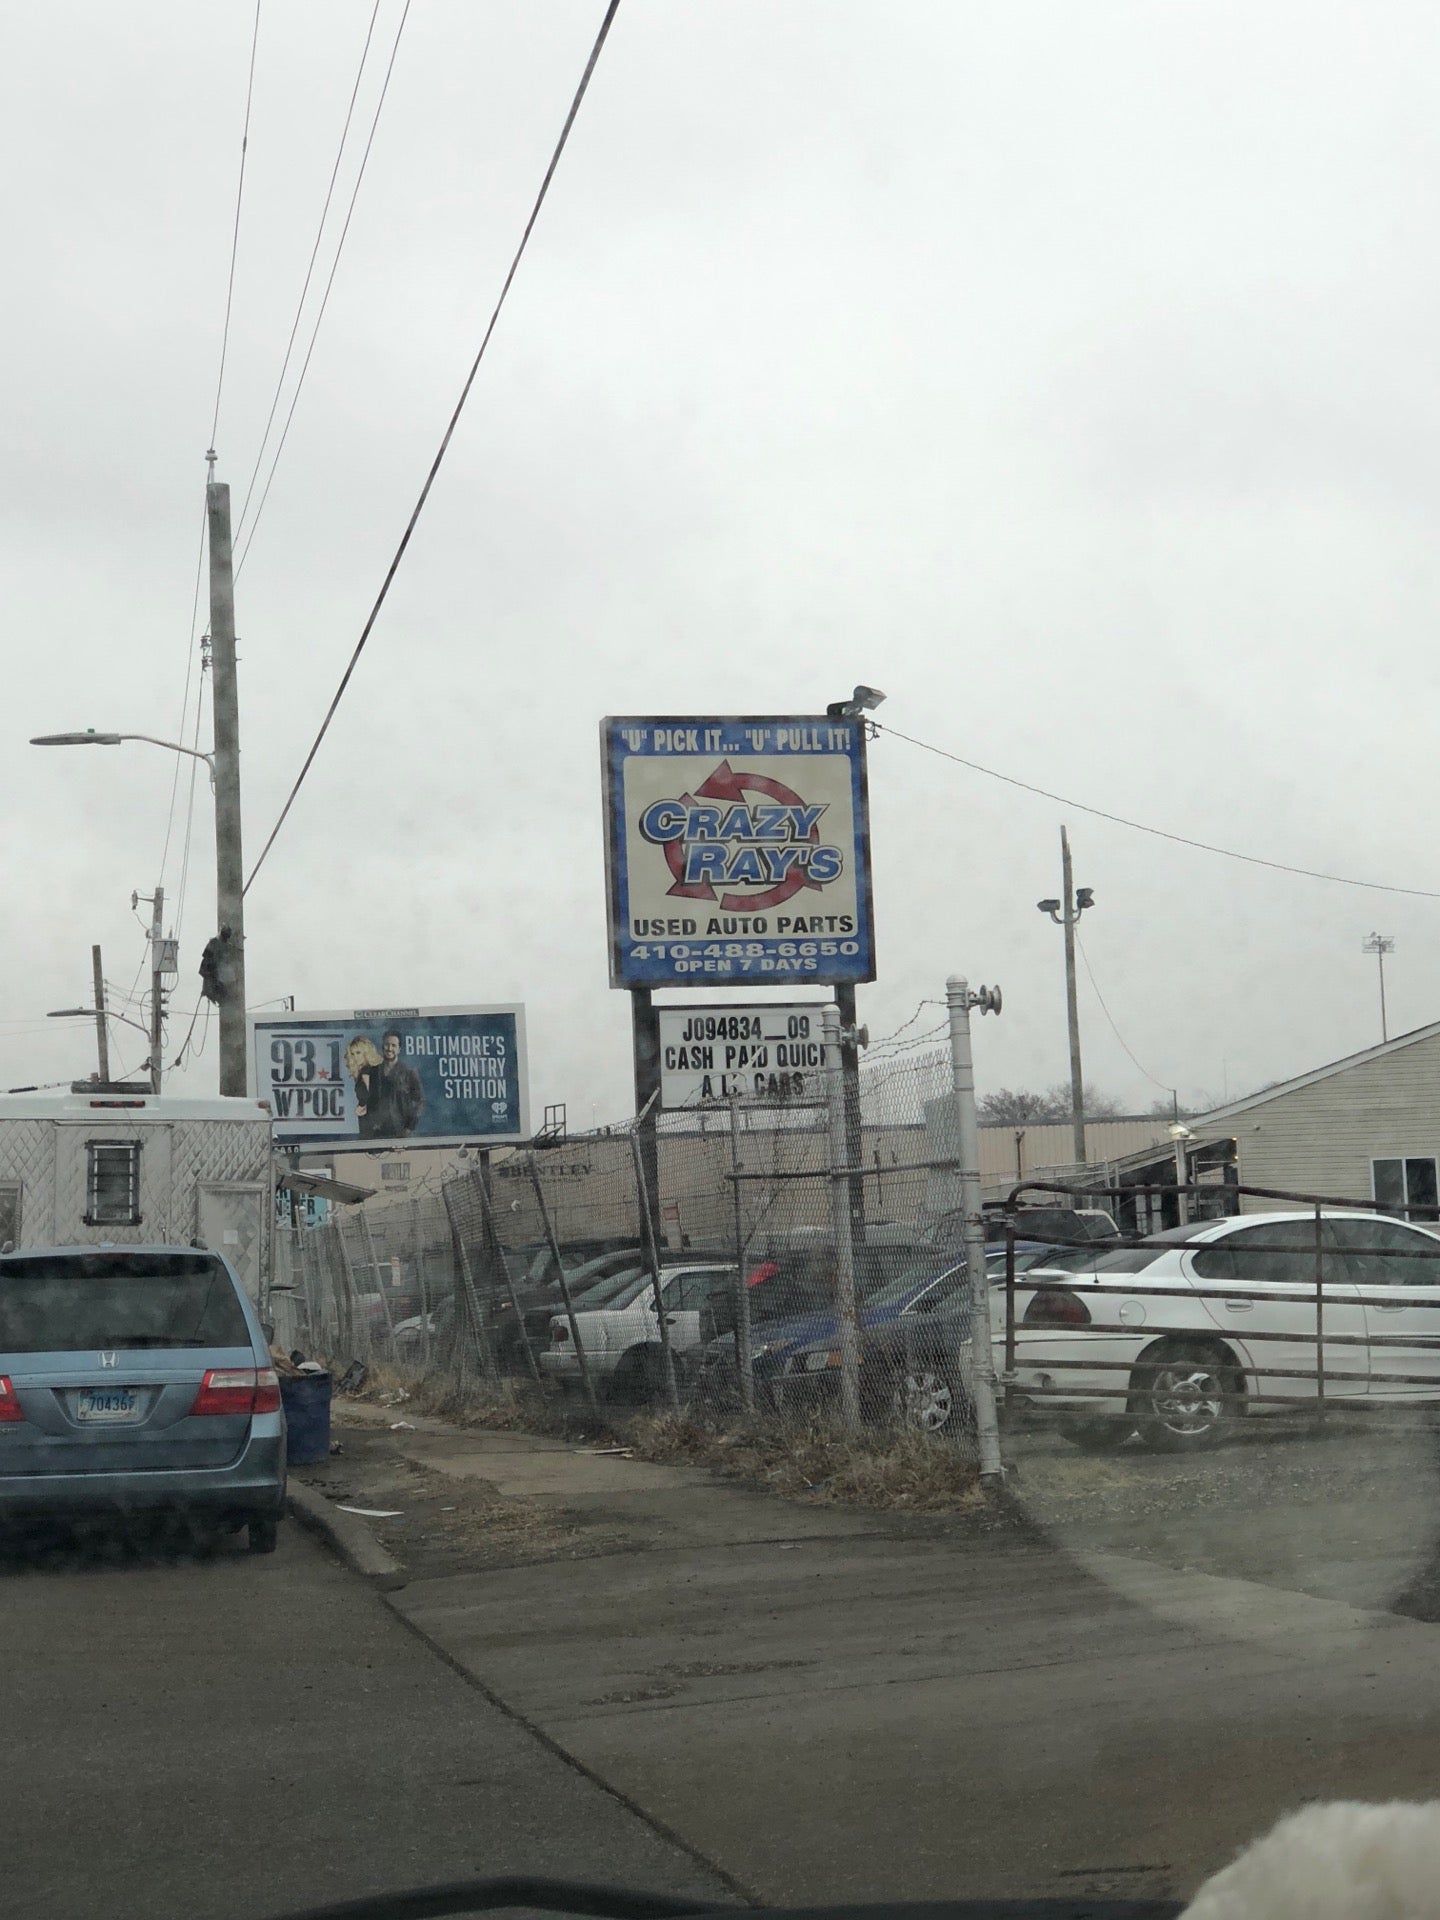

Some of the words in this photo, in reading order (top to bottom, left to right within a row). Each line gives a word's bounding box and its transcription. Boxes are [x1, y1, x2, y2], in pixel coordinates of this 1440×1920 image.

[653, 729, 699, 752] PICK
[704, 728, 740, 751] IT...
[776, 728, 822, 751] PULL
[828, 727, 851, 750] IT!
[639, 799, 830, 844] CRAZY
[683, 842, 843, 886] RAY'S
[633, 918, 697, 937] USED
[706, 916, 768, 936] AUTO
[777, 915, 854, 934] PARTS
[629, 941, 859, 960] 410-488-6650
[674, 959, 732, 973] OPEN
[739, 959, 753, 972] 7
[761, 958, 818, 971] DAYS
[405, 1035, 506, 1056] BALTIMORE'S
[439, 1057, 506, 1078] COUNTRY
[665, 1046, 714, 1070] CASH
[725, 1044, 769, 1069] PAID
[444, 1079, 507, 1099] STATION
[271, 1088, 345, 1117] WPOC
